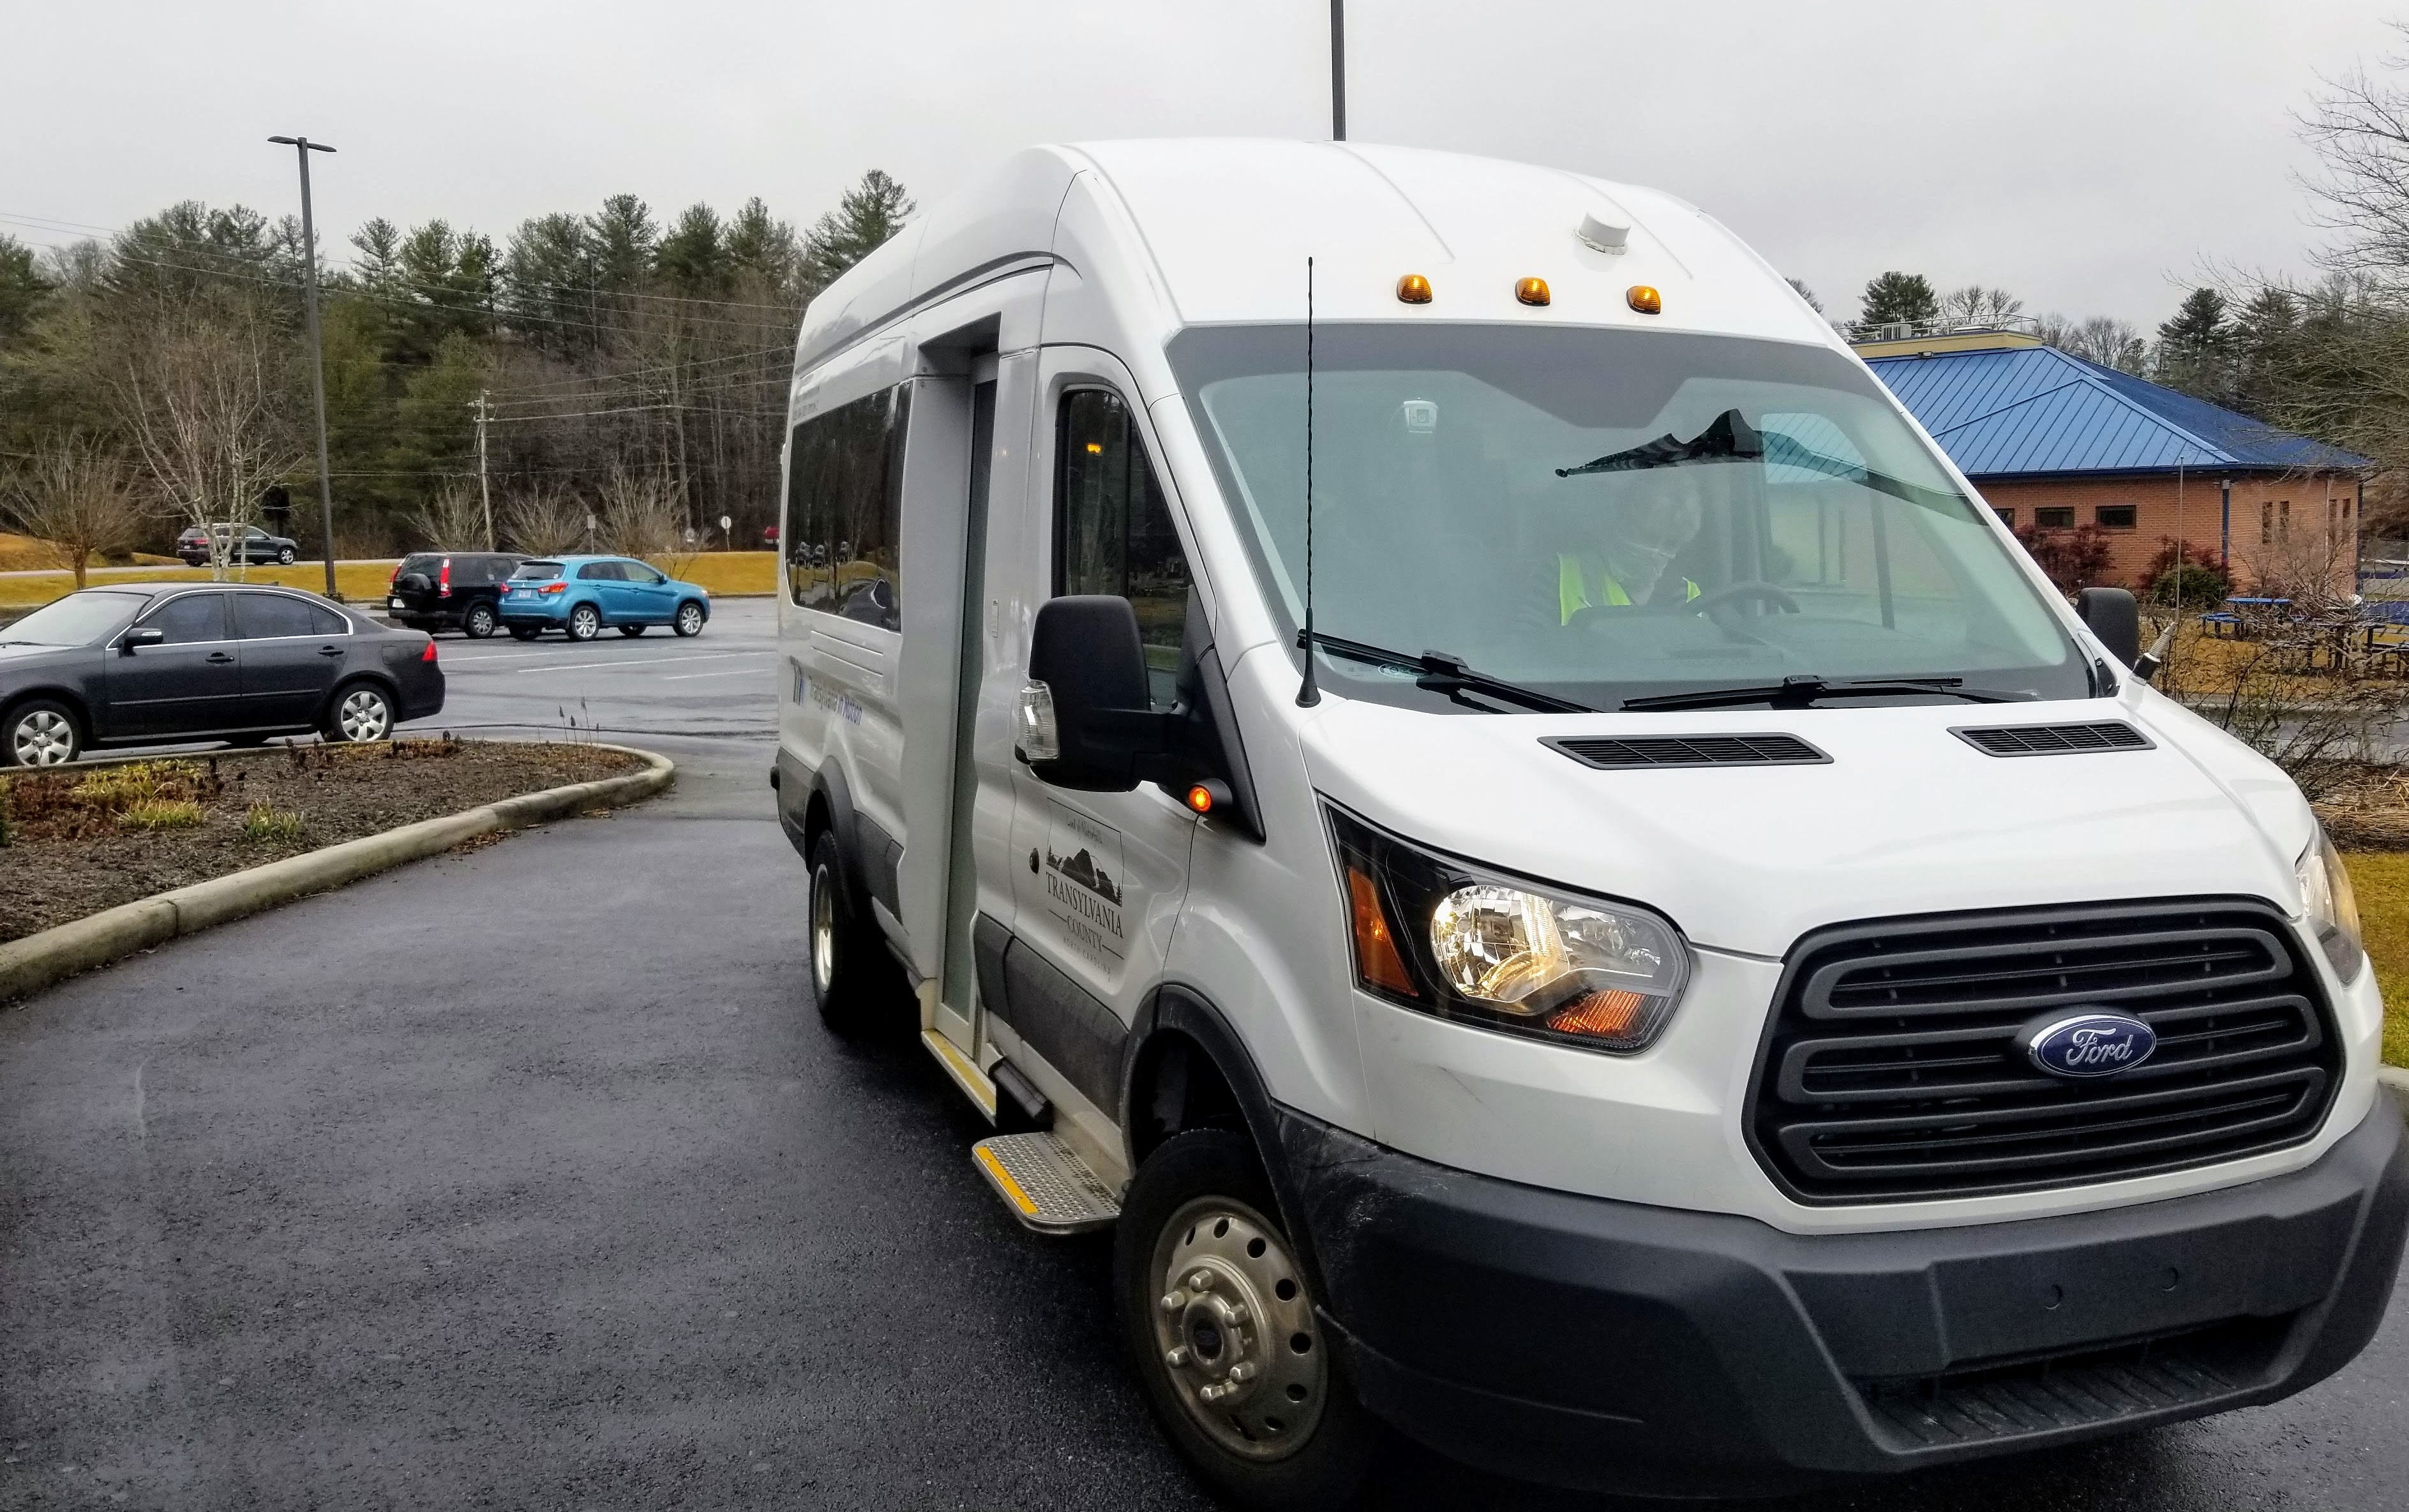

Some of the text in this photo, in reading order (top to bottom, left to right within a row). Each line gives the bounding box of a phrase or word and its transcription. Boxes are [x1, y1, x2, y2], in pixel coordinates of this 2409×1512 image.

[1046, 871, 1123, 938] TRANSYLVANIA
[1067, 915, 1102, 952] COUNTY
[2066, 1028, 2134, 1066] Ford
